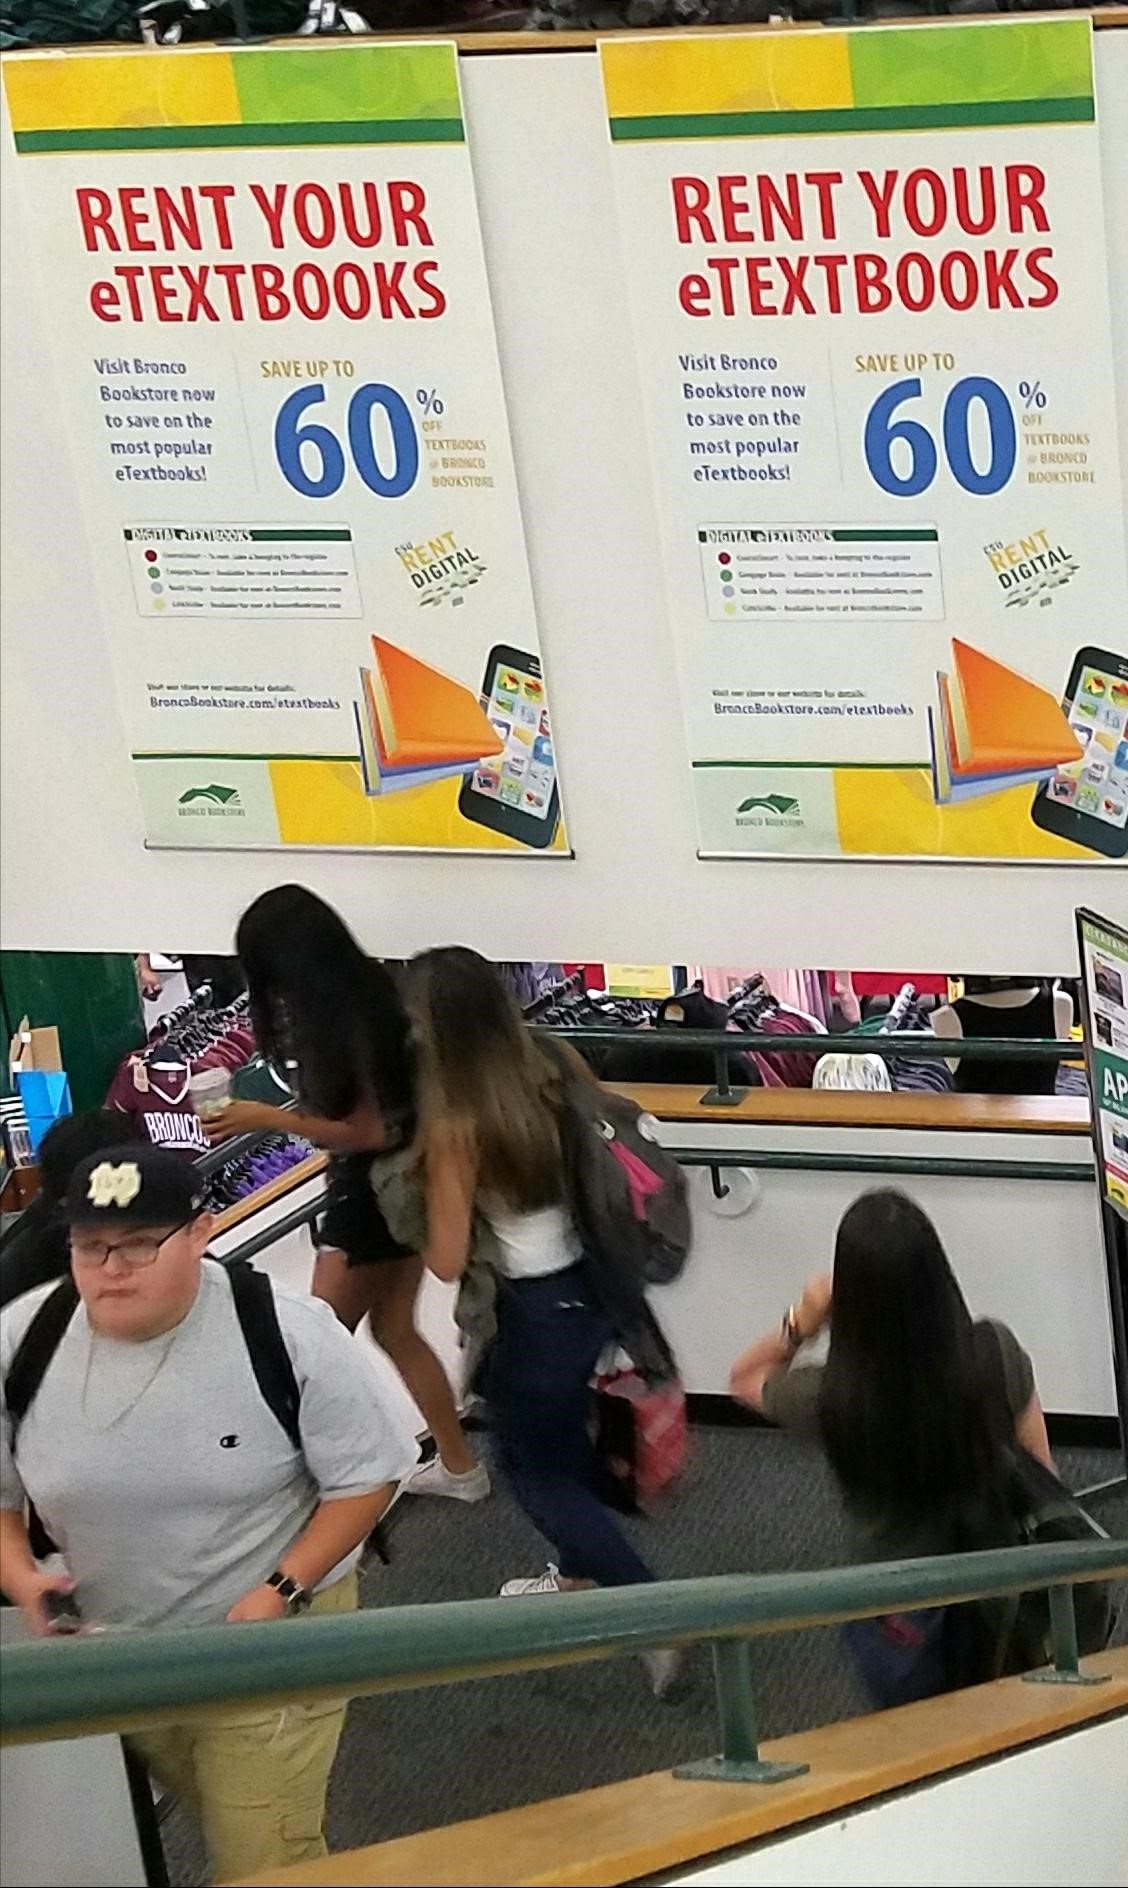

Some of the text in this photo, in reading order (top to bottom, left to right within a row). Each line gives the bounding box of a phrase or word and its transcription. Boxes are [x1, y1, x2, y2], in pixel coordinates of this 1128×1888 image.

[671, 164, 1051, 244] RENT YOUR
[75, 181, 435, 252] RENT YOUR
[678, 247, 1060, 317] eTEXTBOOKS
[89, 260, 447, 322] eTEXTBOOKS
[94, 357, 187, 374] Visit Bronco
[260, 359, 355, 378] SAVE UP TO
[679, 354, 778, 371] Visit Bronco
[855, 353, 956, 372] SAVE UP TO
[100, 385, 216, 401] Bookstore now
[683, 382, 807, 399] Bookstore now
[105, 412, 213, 428] to save on the
[422, 421, 442, 432] OFF
[686, 409, 801, 427] to save on the
[1022, 414, 1042, 426] OFF
[425, 439, 487, 451] TEXTBOOKS
[690, 437, 800, 457] most popular
[1024, 433, 1090, 445] TEXTBOOKS
[110, 440, 213, 458] most popular
[441, 458, 486, 469] BRONCO
[1040, 452, 1088, 464] BRONCO
[115, 465, 207, 481] eTextbooks!
[693, 465, 791, 481] eTextbooks!
[1028, 472, 1096, 484] BOOKSTORE
[432, 476, 495, 488] BOOKSTORE
[399, 530, 459, 573] RENT
[988, 528, 1050, 573] RENT
[410, 547, 480, 589] DIGITAL
[998, 545, 1073, 590] DIGITAL
[150, 696, 341, 710] BroncoBookstore.com/etextbooks
[714, 703, 914, 716] BroncoBookstore.com/etextbooks
